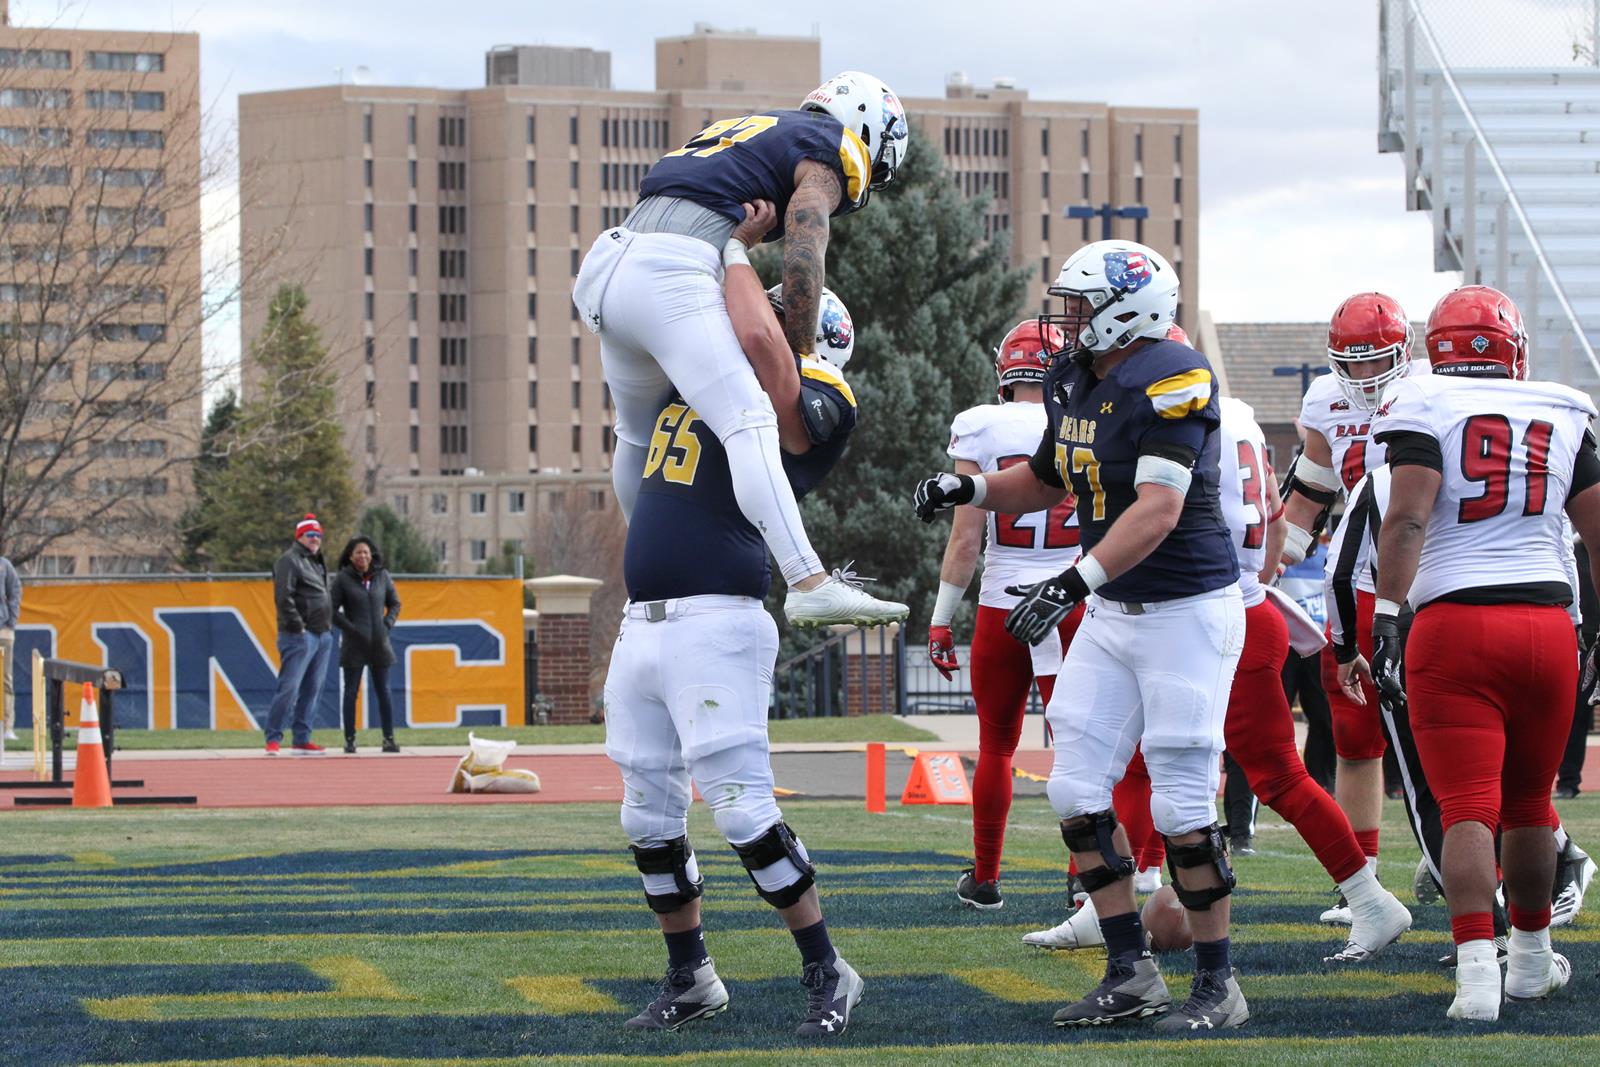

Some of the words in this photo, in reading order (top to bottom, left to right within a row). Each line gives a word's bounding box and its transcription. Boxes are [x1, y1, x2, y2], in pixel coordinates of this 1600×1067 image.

[1437, 366, 1456, 374] LEAVE
[642, 403, 702, 486] 65
[1059, 415, 1096, 444] BEARS
[1457, 413, 1554, 524] 91
[1055, 442, 1106, 521] 77
[1237, 440, 1271, 549] 3
